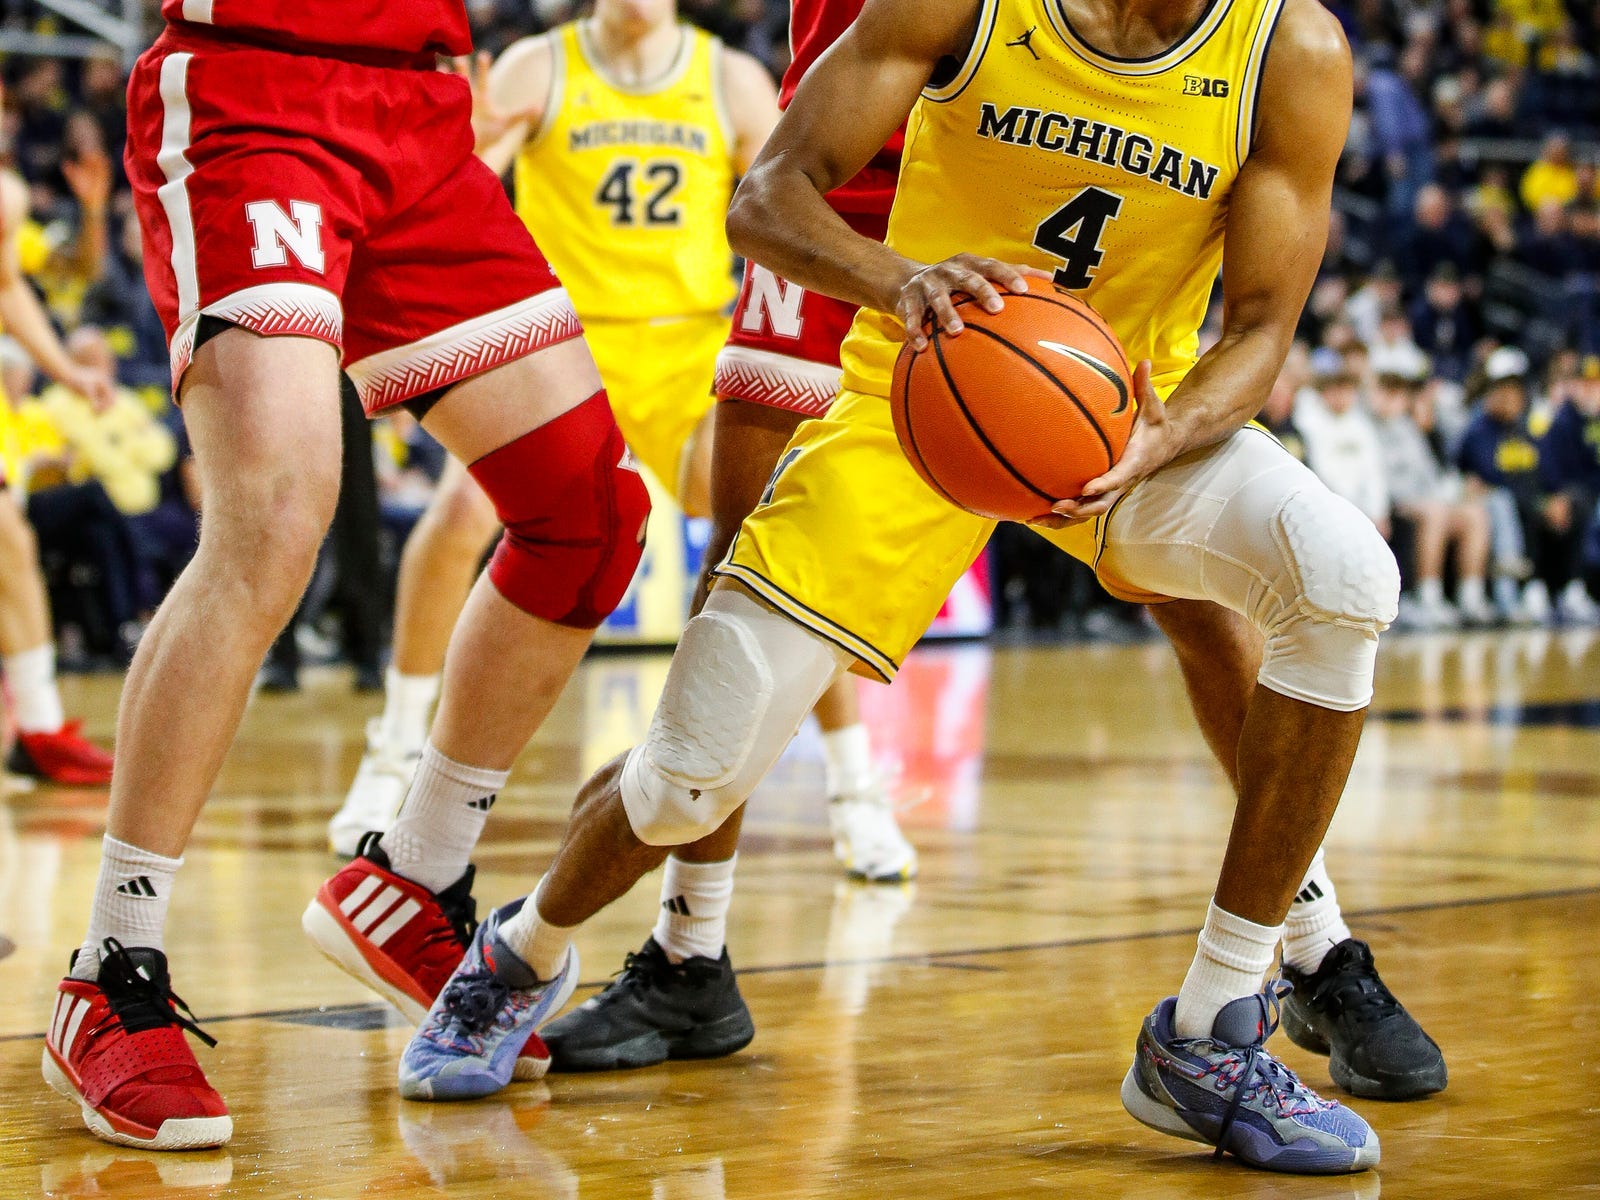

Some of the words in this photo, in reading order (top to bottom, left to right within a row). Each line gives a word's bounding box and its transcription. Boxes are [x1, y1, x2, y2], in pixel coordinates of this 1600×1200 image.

[568, 118, 709, 156] MICHIGAN
[977, 102, 1221, 200] MICHIGAN
[593, 155, 687, 229] 42
[245, 199, 326, 275] N
[1032, 185, 1124, 291] 4
